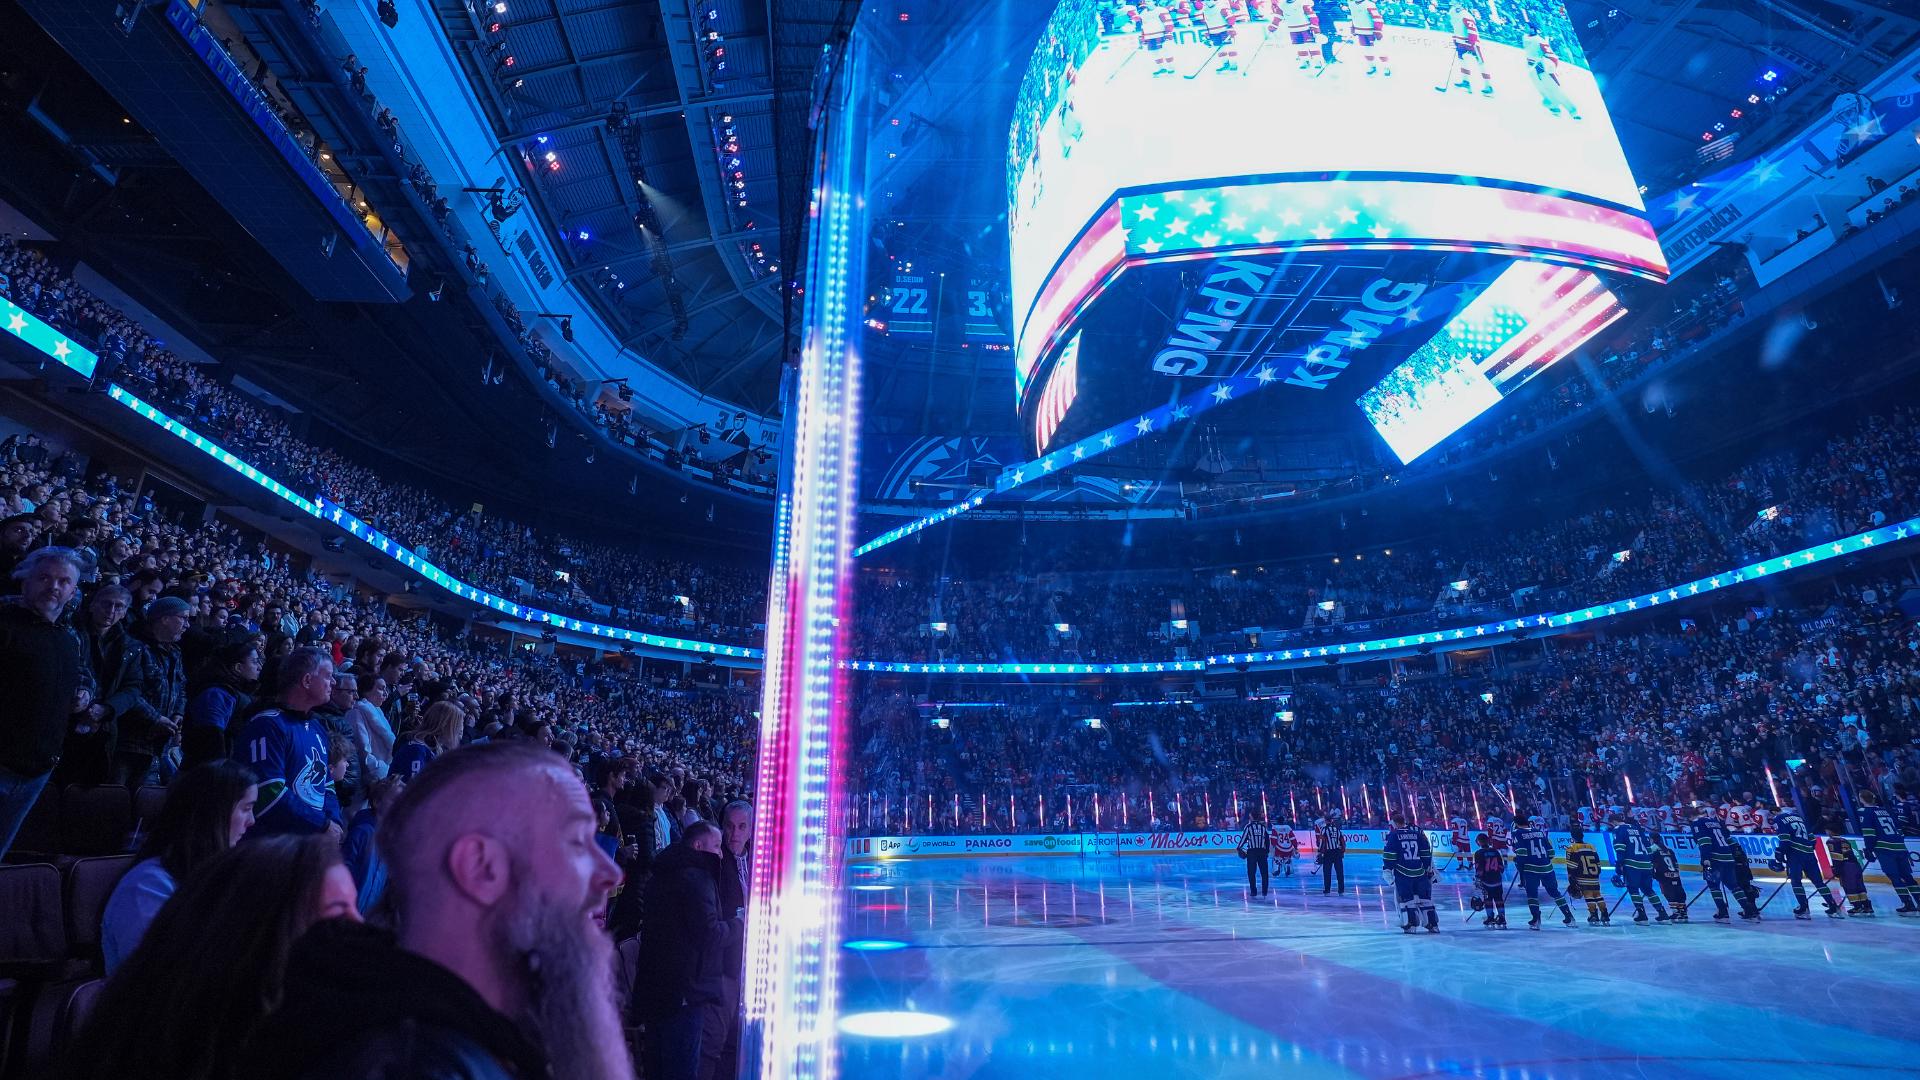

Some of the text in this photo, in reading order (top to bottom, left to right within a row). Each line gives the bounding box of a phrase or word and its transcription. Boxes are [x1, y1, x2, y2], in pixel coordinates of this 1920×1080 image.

[892, 287, 928, 314] 22
[967, 290, 994, 317] 3
[1153, 260, 1275, 377] KPMG
[1284, 277, 1428, 390] KPMG
[250, 736, 267, 763] 11
[1148, 832, 1209, 849] Molson
[1790, 822, 1809, 841] 29
[965, 838, 1012, 849] PANAGO
[1401, 840, 1420, 860] 32
[1530, 839, 1547, 859] 44
[1580, 855, 1599, 875] 15
[1663, 856, 1675, 871] 9
